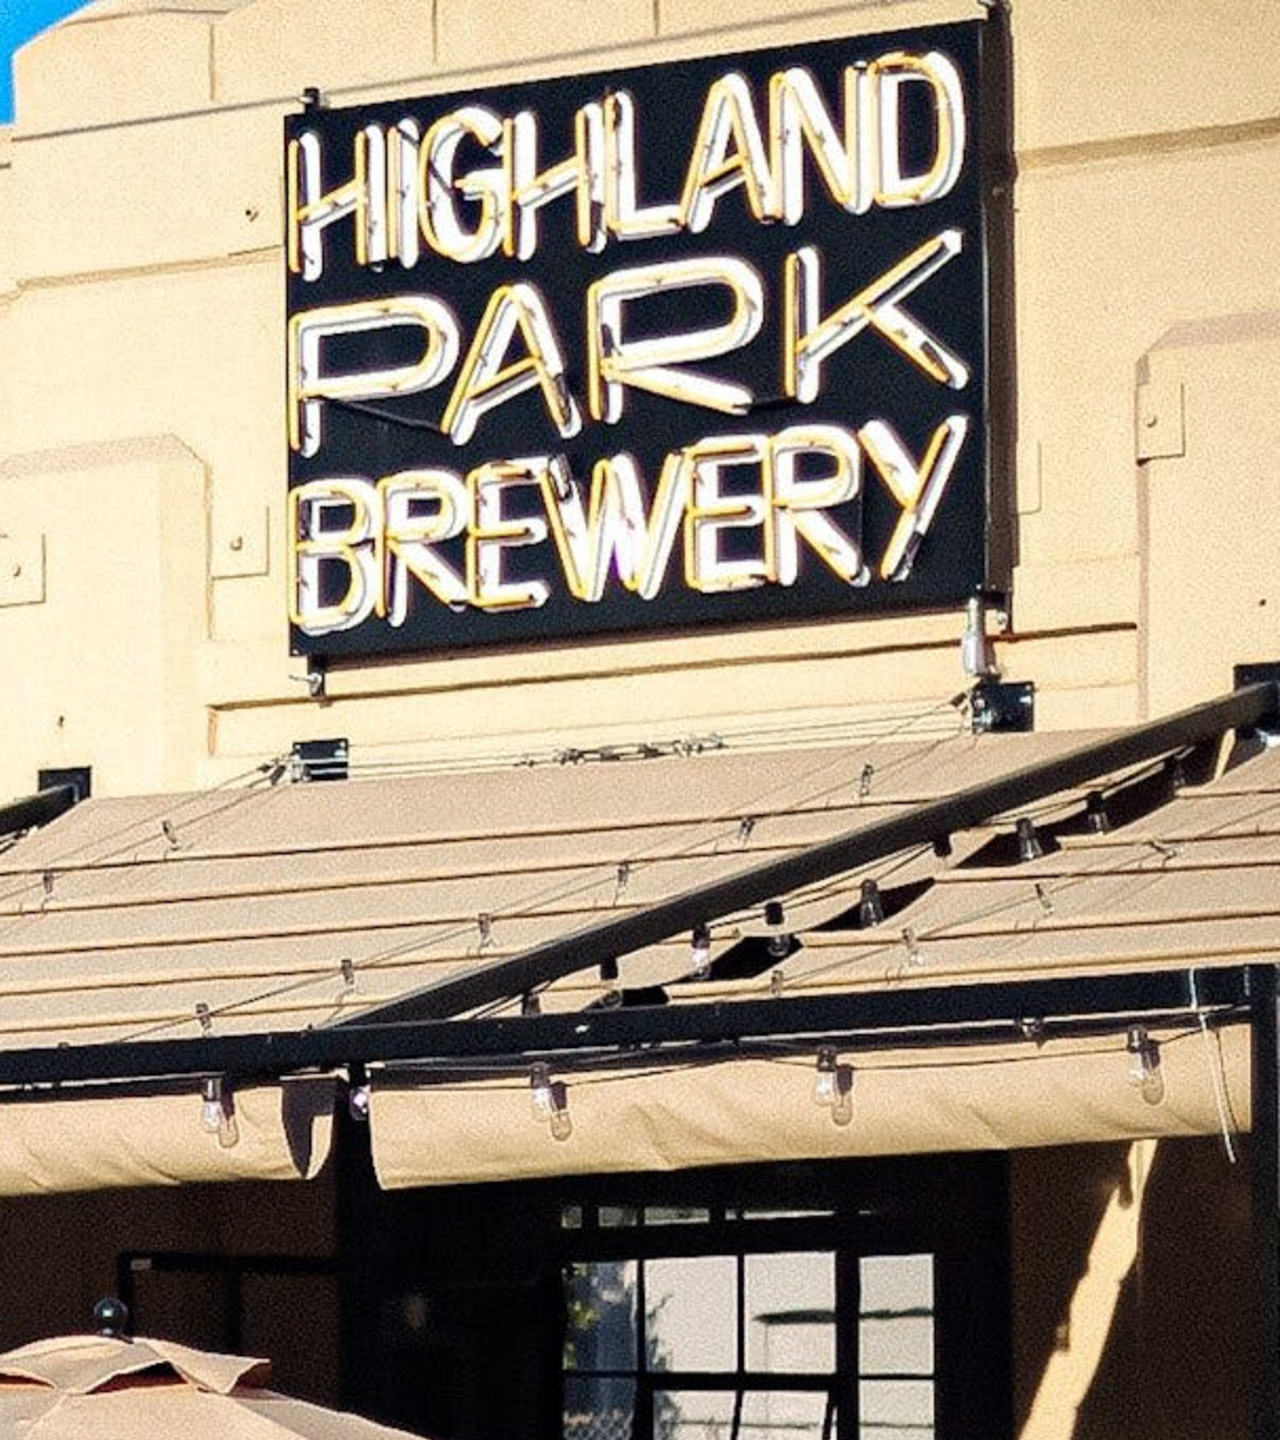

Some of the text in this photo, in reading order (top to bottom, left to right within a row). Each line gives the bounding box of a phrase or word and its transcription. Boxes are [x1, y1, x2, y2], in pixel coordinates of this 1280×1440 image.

[289, 51, 965, 282] HIGHLAND
[289, 228, 969, 458] PARK
[289, 415, 968, 637] BREWERY
